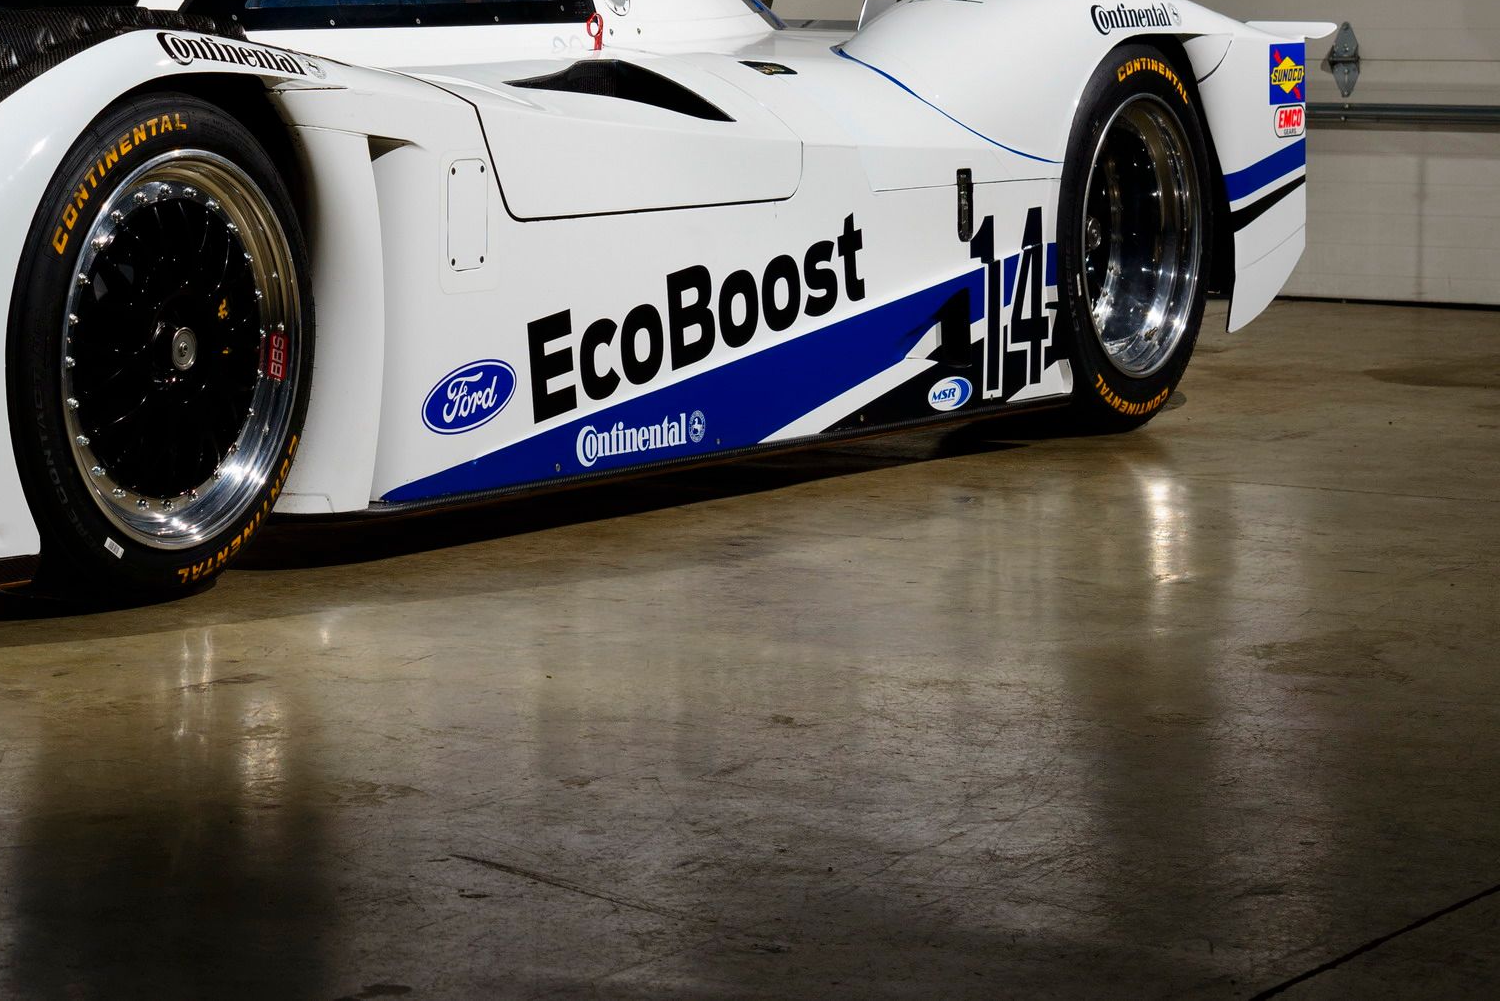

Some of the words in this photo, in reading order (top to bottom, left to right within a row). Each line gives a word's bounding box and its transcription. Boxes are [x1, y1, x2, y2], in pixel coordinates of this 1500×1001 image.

[1091, 2, 1171, 35] Continental
[156, 32, 308, 76] Continental
[1272, 67, 1303, 83] SUNOCO
[1117, 57, 1189, 104] CONTINENTAL
[1278, 108, 1303, 128] EMCO
[51, 112, 188, 255] CONTINENTAL
[527, 212, 866, 424] EcoBoost
[970, 206, 1050, 391] 14
[270, 335, 285, 378] BBS
[442, 370, 499, 424] Ford
[932, 387, 957, 401] MSR
[1096, 373, 1169, 415] CONTINENTAL
[576, 412, 687, 467] Continental
